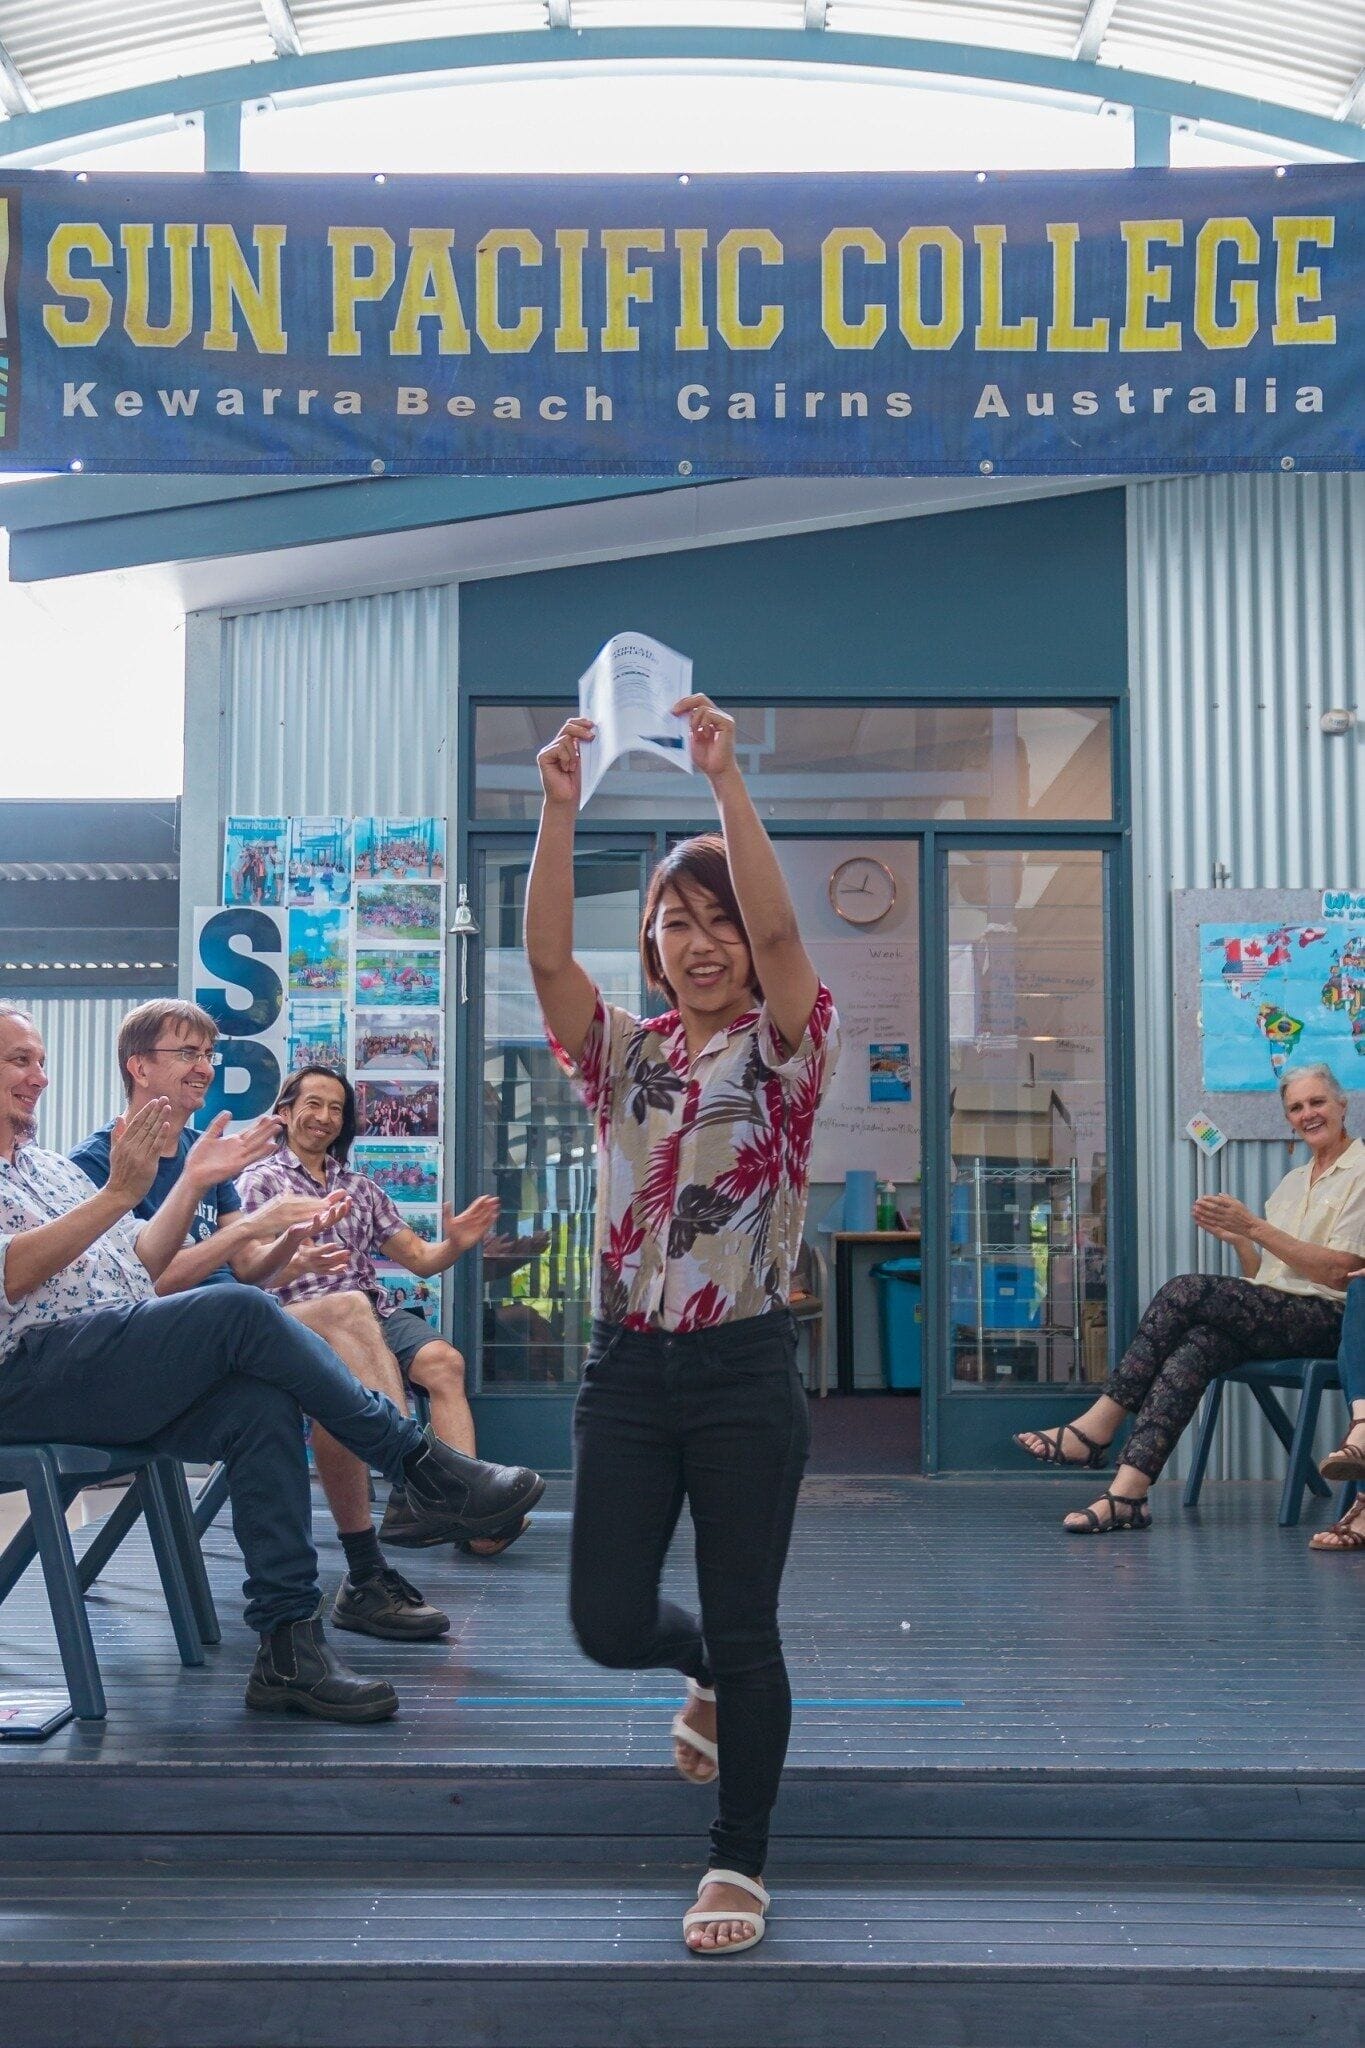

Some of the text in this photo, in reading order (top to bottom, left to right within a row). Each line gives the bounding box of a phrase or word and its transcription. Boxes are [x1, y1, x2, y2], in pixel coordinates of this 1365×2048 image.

[42, 216, 1337, 356] SUN PACIFIC COLLEGE
[62, 377, 1325, 421] Kewarra Beach Cairns Australia
